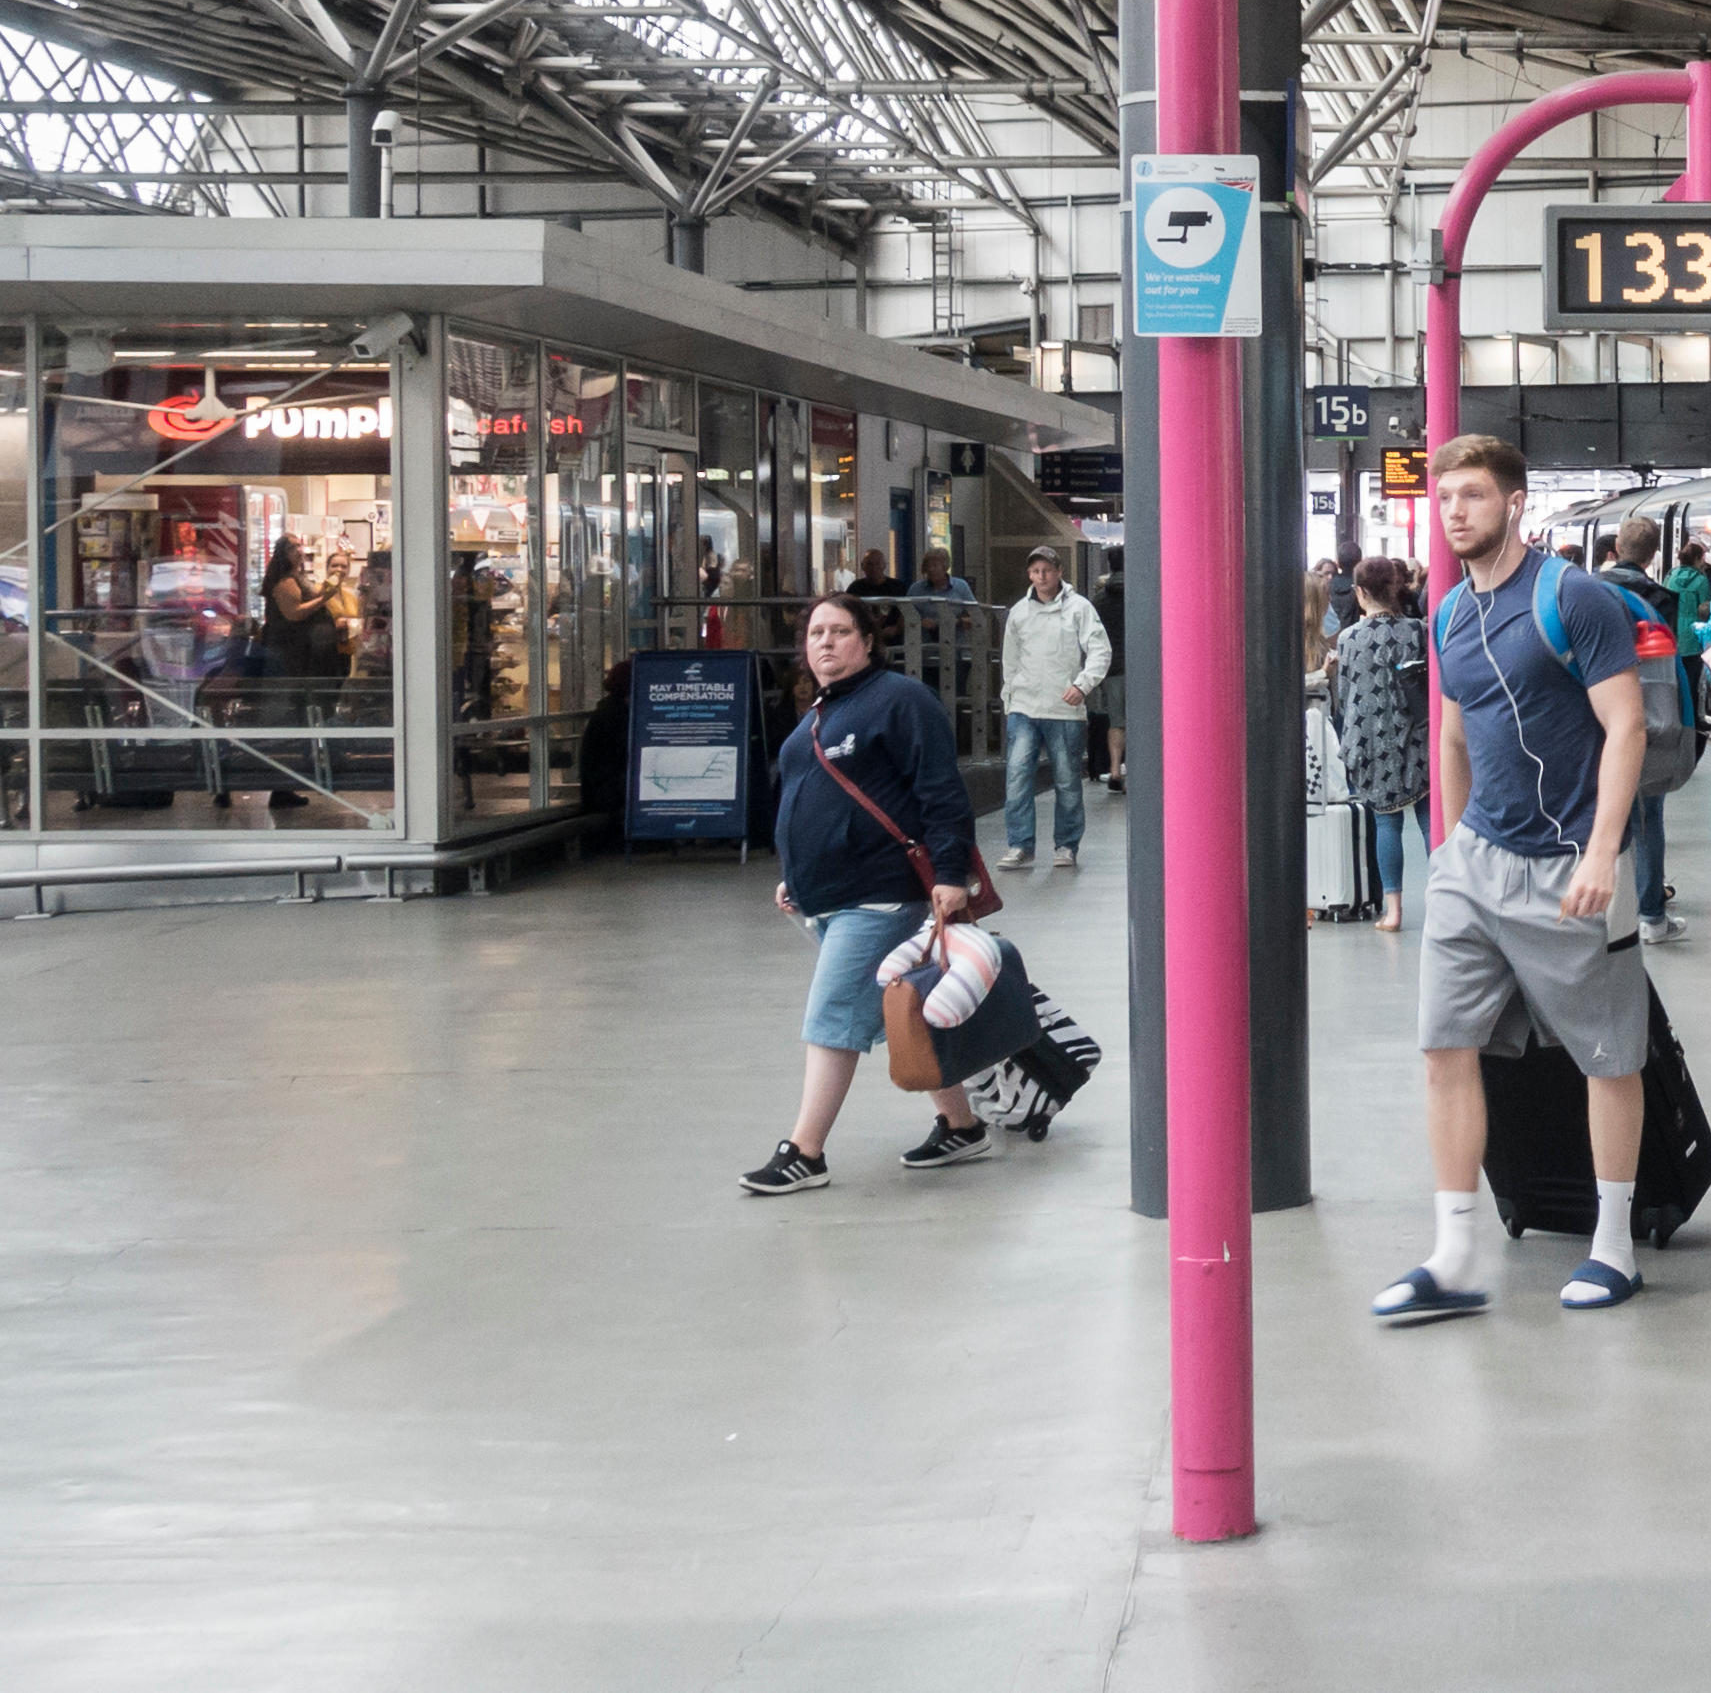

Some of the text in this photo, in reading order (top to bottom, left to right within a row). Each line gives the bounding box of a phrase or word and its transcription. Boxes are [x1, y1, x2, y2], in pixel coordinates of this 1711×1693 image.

[1176, 272, 1221, 285] watching
[1144, 286, 1199, 297] out for you
[1316, 396, 1368, 426] 15b
[549, 414, 583, 435] sh
[1313, 495, 1336, 510] 15b
[650, 683, 735, 692] MAY TIMETABLE
[649, 692, 735, 702] COMPENSATION
